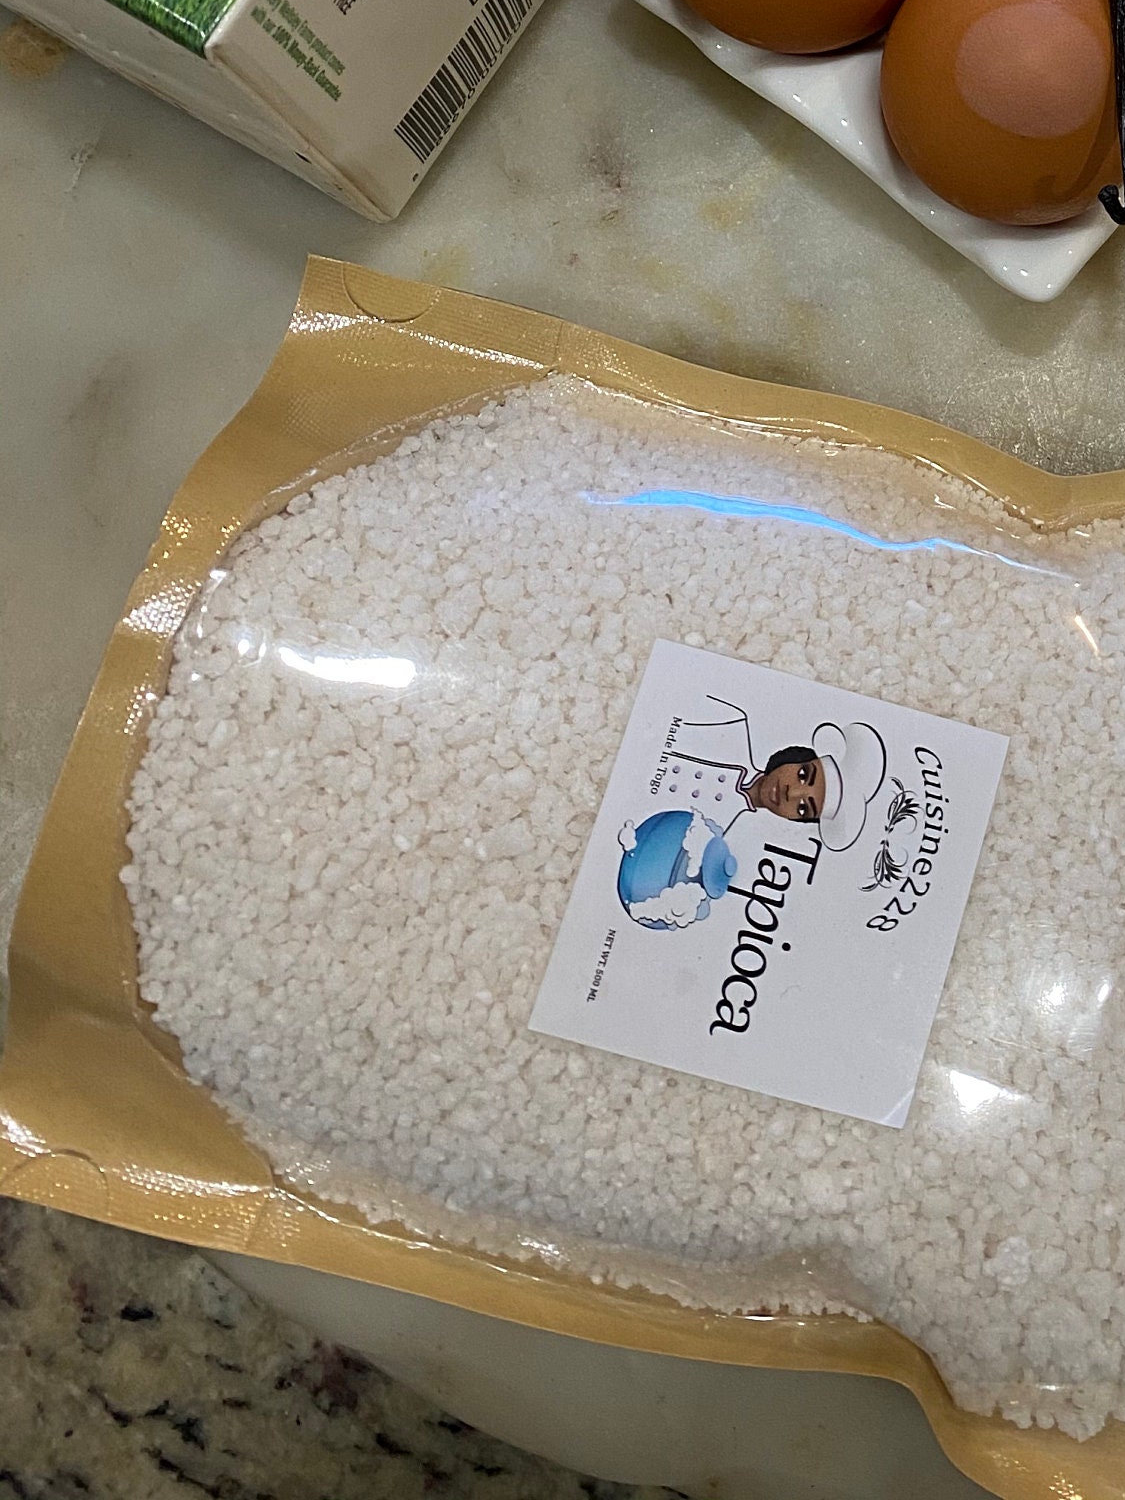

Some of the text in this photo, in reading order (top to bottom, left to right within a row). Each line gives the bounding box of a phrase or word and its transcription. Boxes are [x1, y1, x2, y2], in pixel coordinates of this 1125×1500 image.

[664, 716, 683, 749] Made
[649, 767, 668, 795] Togo
[866, 747, 949, 932] Cuisine228
[603, 928, 617, 950] NET
[709, 837, 822, 1036] Tapioca
[592, 968, 604, 987] 500
